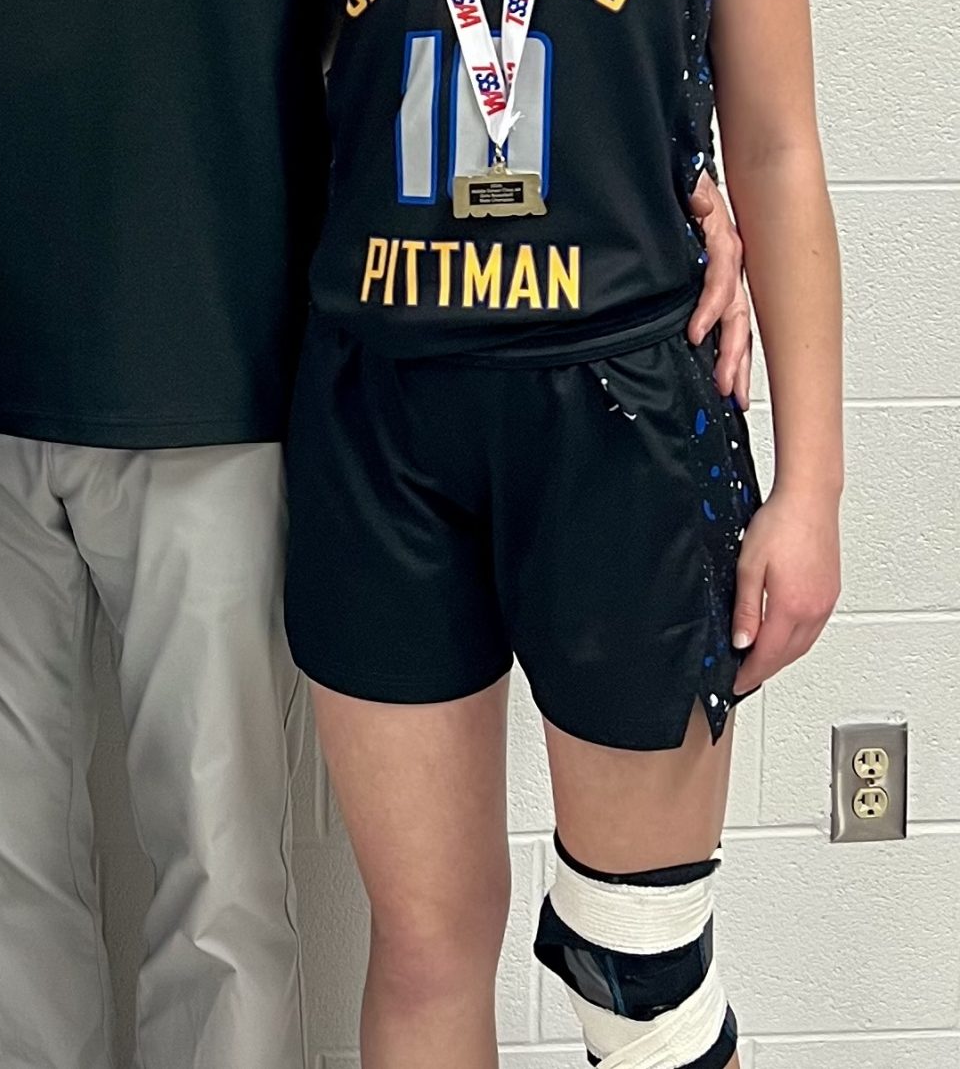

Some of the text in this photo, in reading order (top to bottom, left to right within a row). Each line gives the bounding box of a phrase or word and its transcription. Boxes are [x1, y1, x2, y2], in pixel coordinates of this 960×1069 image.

[395, 30, 554, 205] 10
[472, 62, 507, 116] TSSAA
[359, 236, 581, 310] PITTMAN
